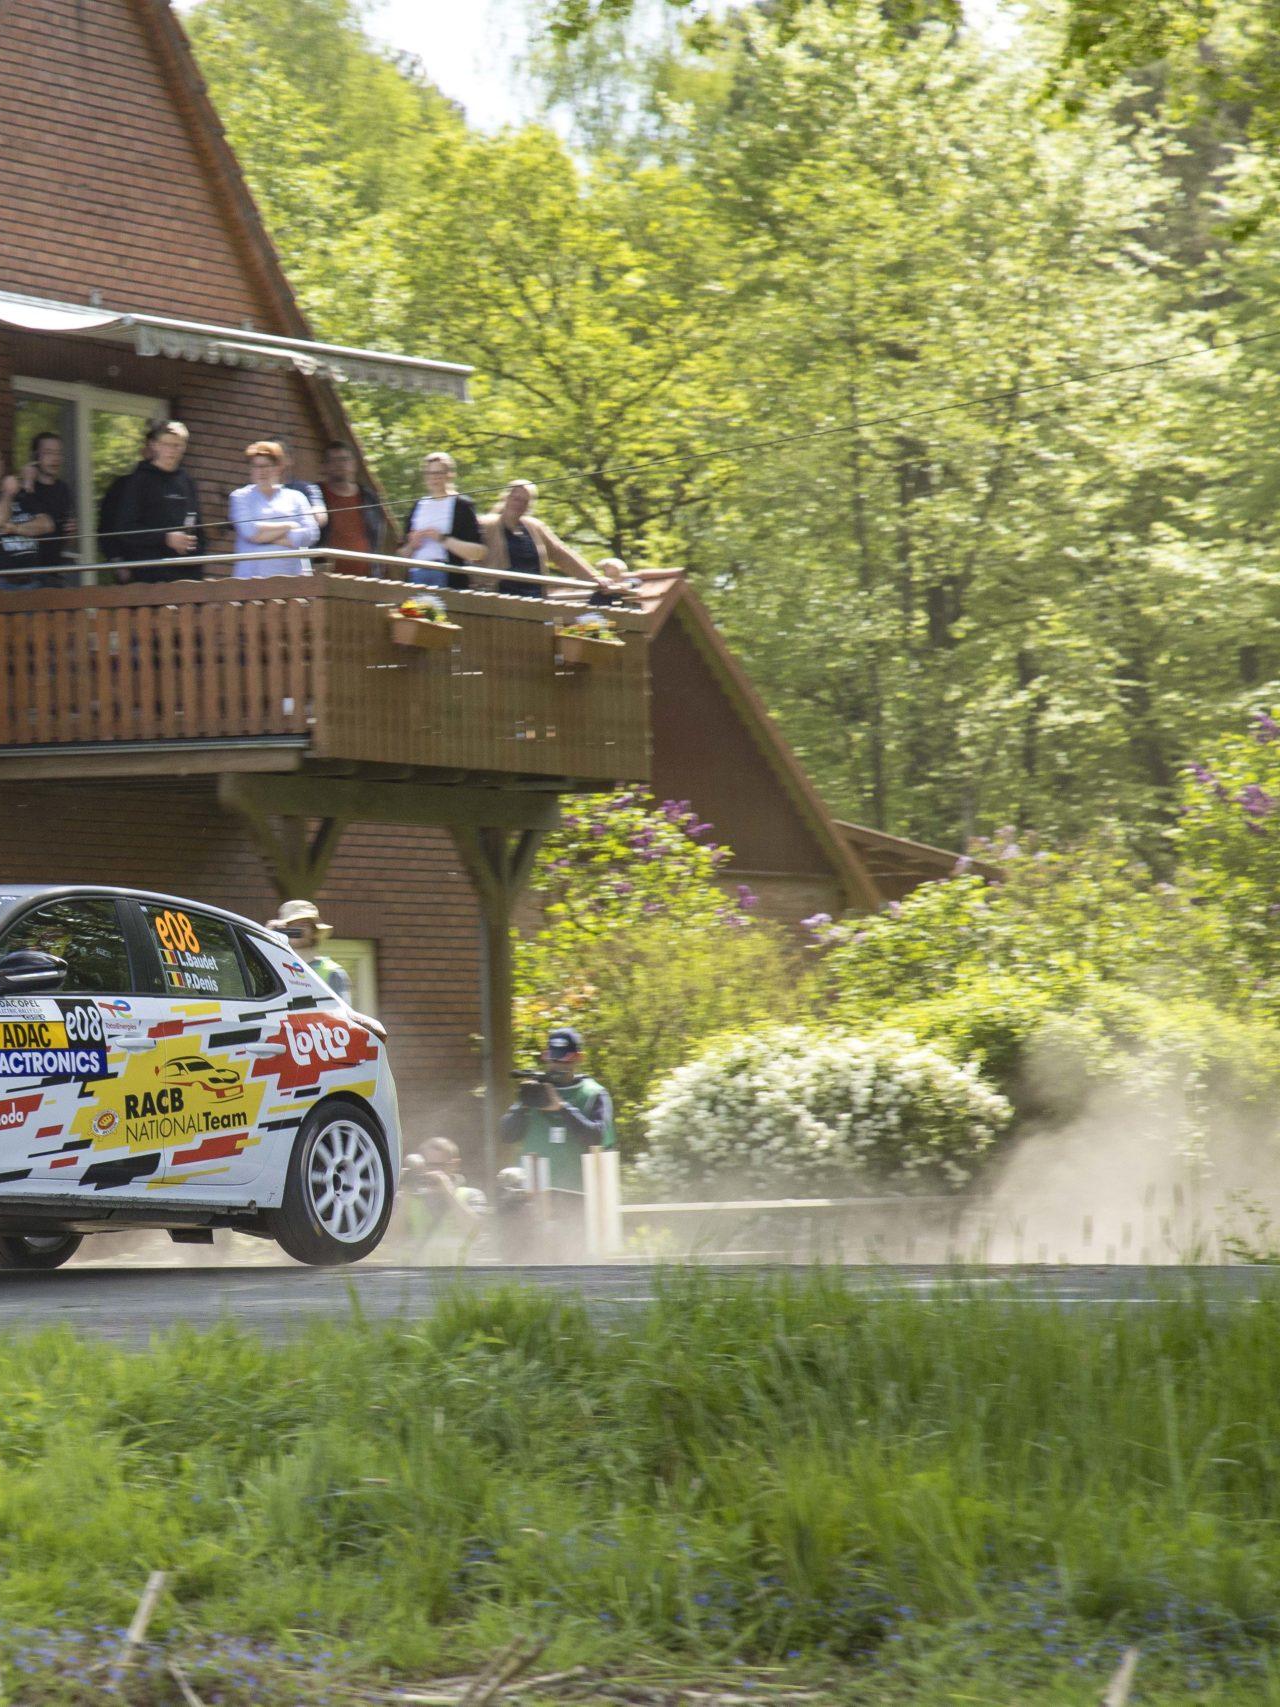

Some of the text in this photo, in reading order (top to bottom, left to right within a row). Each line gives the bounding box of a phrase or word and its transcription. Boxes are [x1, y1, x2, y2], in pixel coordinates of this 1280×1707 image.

[17, 999, 40, 1007] OPEL
[3, 1023, 52, 1048] ADAC
[65, 1006, 102, 1042] e08
[124, 1087, 185, 1120] RACB
